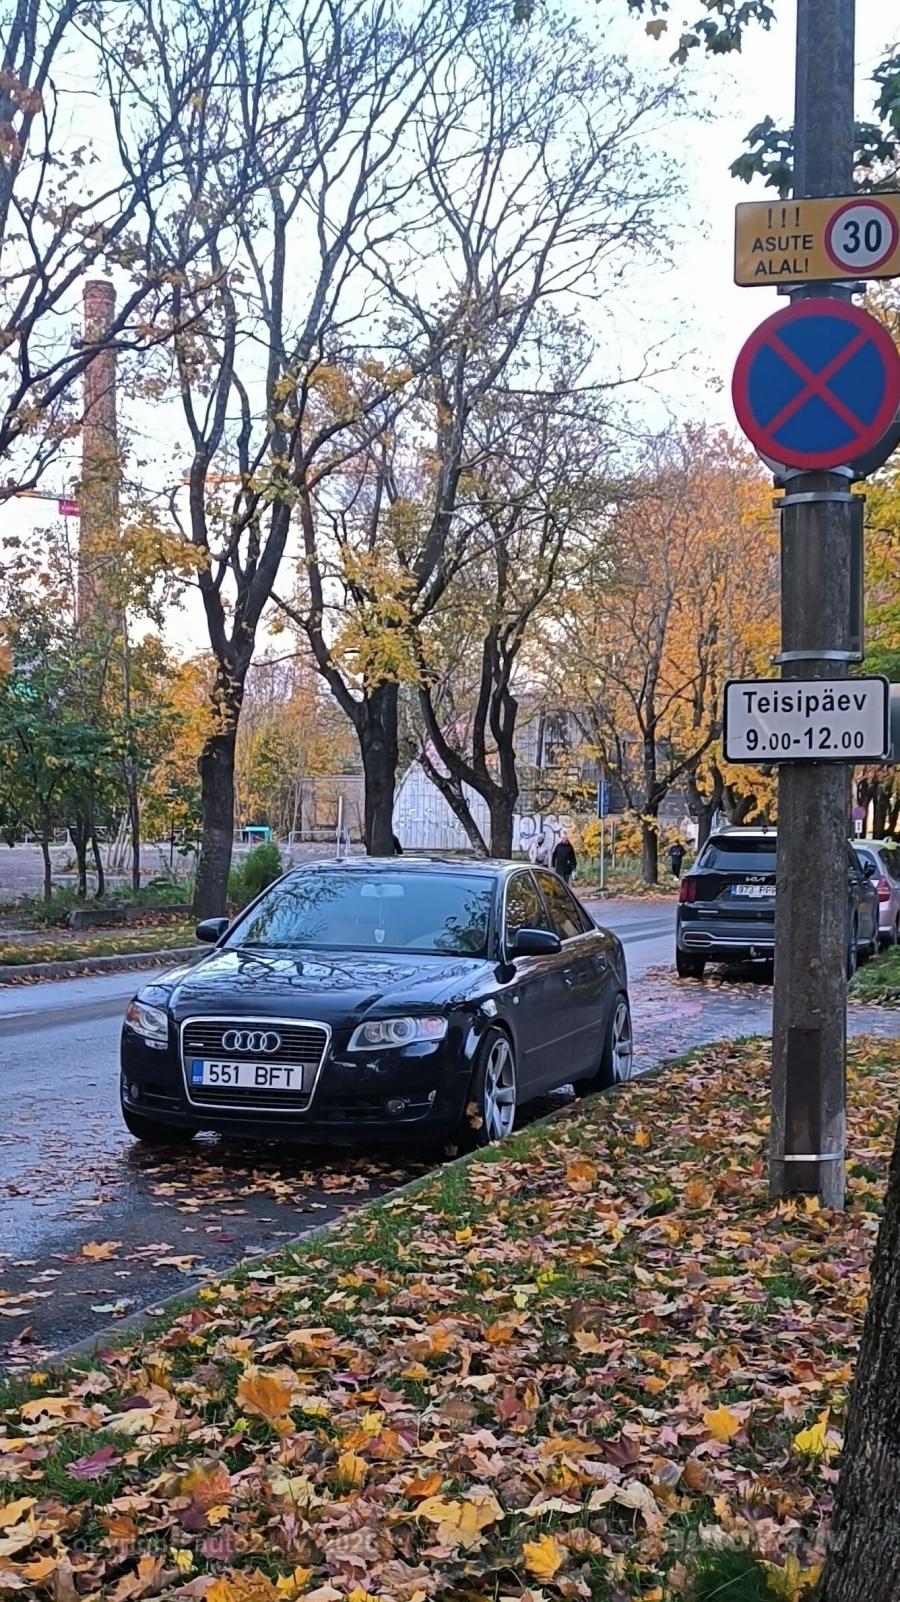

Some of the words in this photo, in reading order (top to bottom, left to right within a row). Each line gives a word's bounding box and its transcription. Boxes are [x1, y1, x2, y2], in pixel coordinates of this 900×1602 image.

[752, 234, 813, 253] ASUTE
[843, 219, 882, 254] 30
[755, 258, 809, 276] ALAL!
[743, 688, 867, 718] Teisipäev
[746, 727, 864, 751] 9.00-12.00
[209, 1064, 240, 1084] 551
[255, 1066, 295, 1087] BFT
